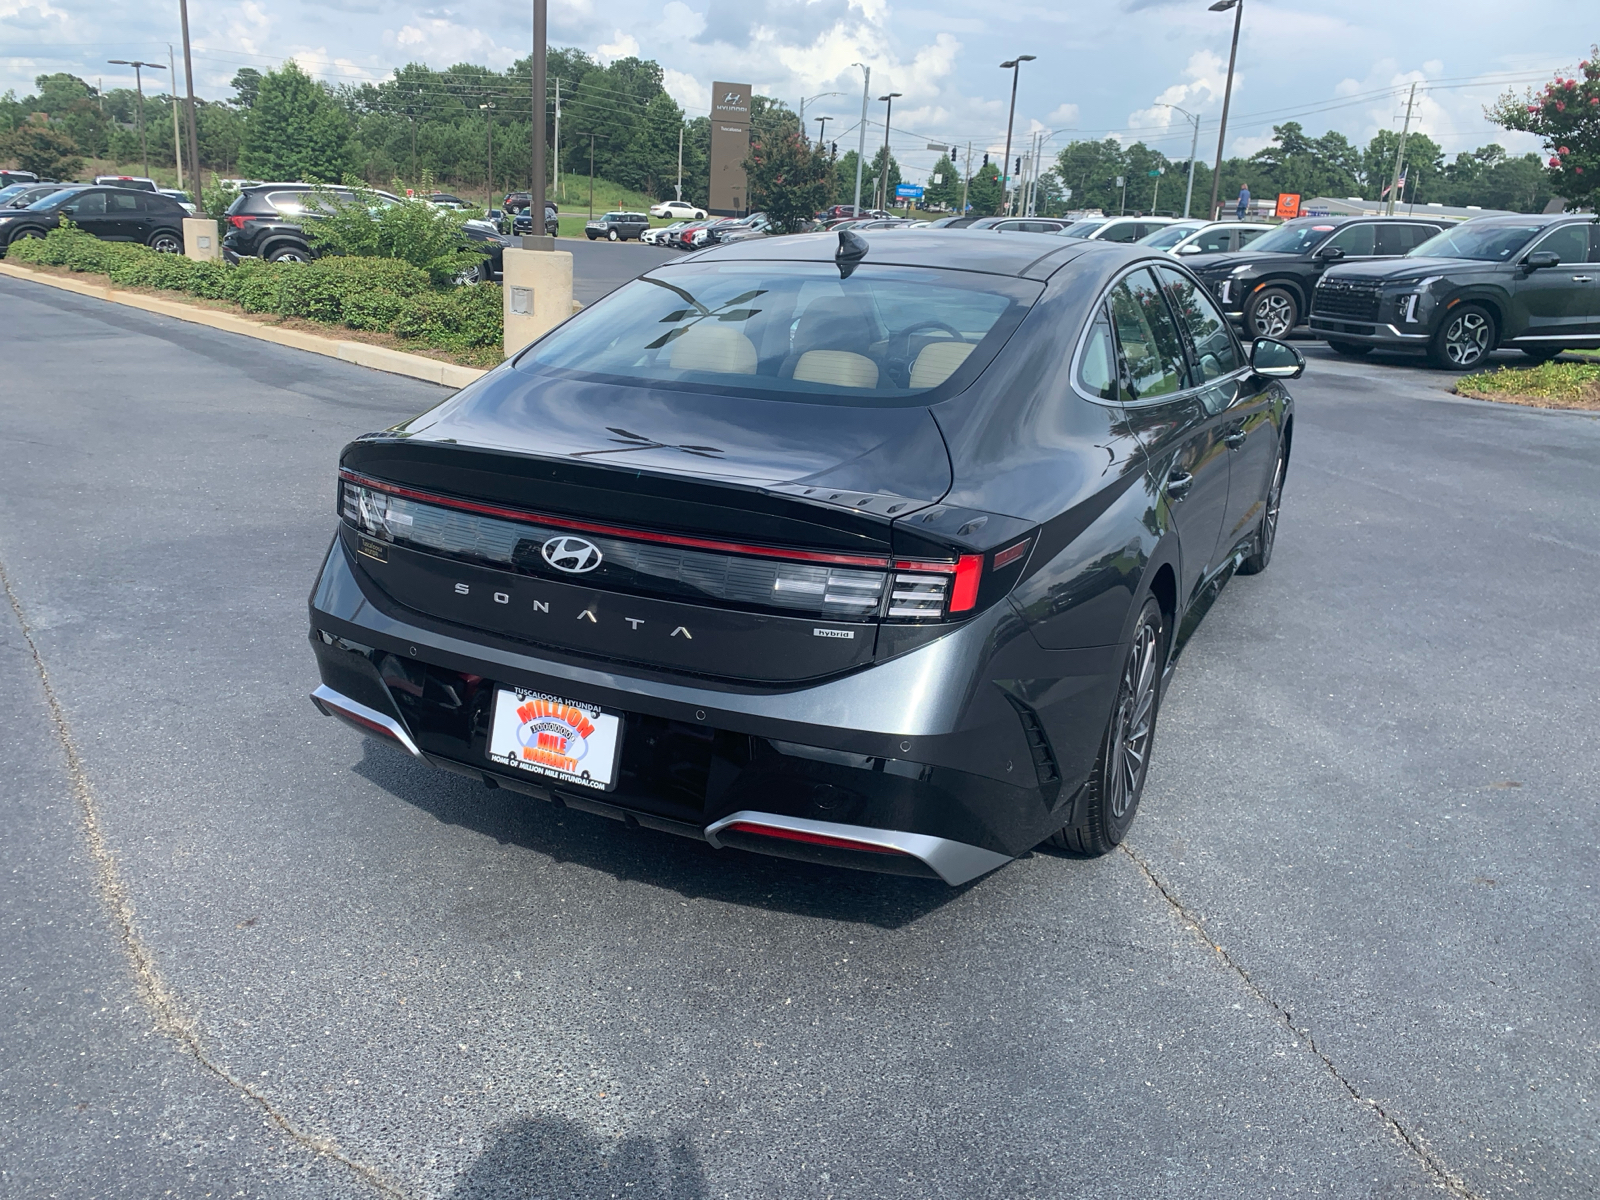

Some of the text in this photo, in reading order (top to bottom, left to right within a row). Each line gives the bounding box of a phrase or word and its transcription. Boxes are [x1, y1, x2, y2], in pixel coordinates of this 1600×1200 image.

[454, 582, 693, 640] SONATA
[818, 629, 849, 638] hybrid
[514, 687, 601, 713] TUSCALOOSA HYUNDAI
[516, 699, 595, 739] MILLION
[537, 732, 567, 756] MILE
[491, 754, 605, 790] HOME OF MILLION MILE HYUNDAI.COM
[523, 746, 578, 772] WARRANTY
